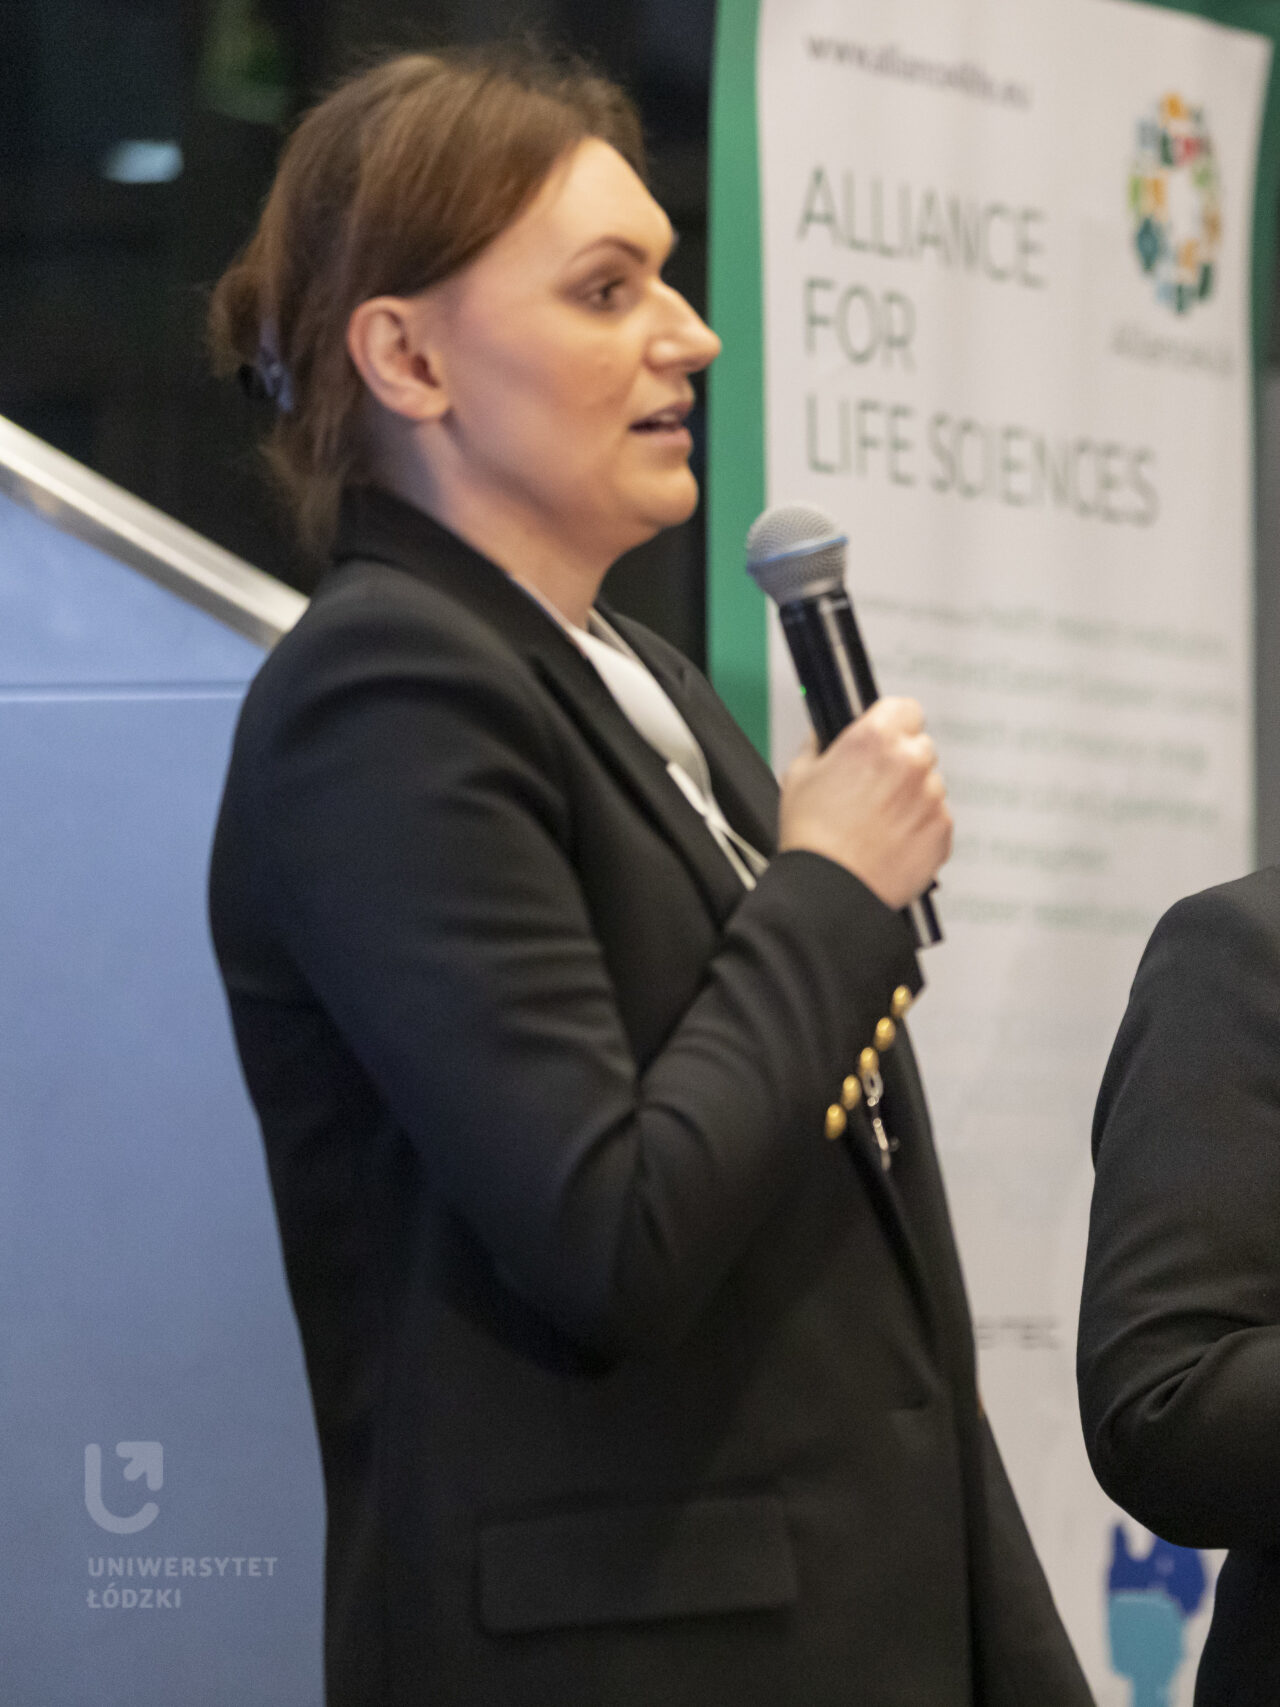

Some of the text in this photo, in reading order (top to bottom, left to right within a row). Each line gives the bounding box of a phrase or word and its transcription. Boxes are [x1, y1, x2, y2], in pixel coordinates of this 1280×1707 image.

[798, 163, 1048, 289] ALLIANCE
[804, 277, 917, 371] FOR
[806, 395, 1160, 528] LIFE SCIENCES
